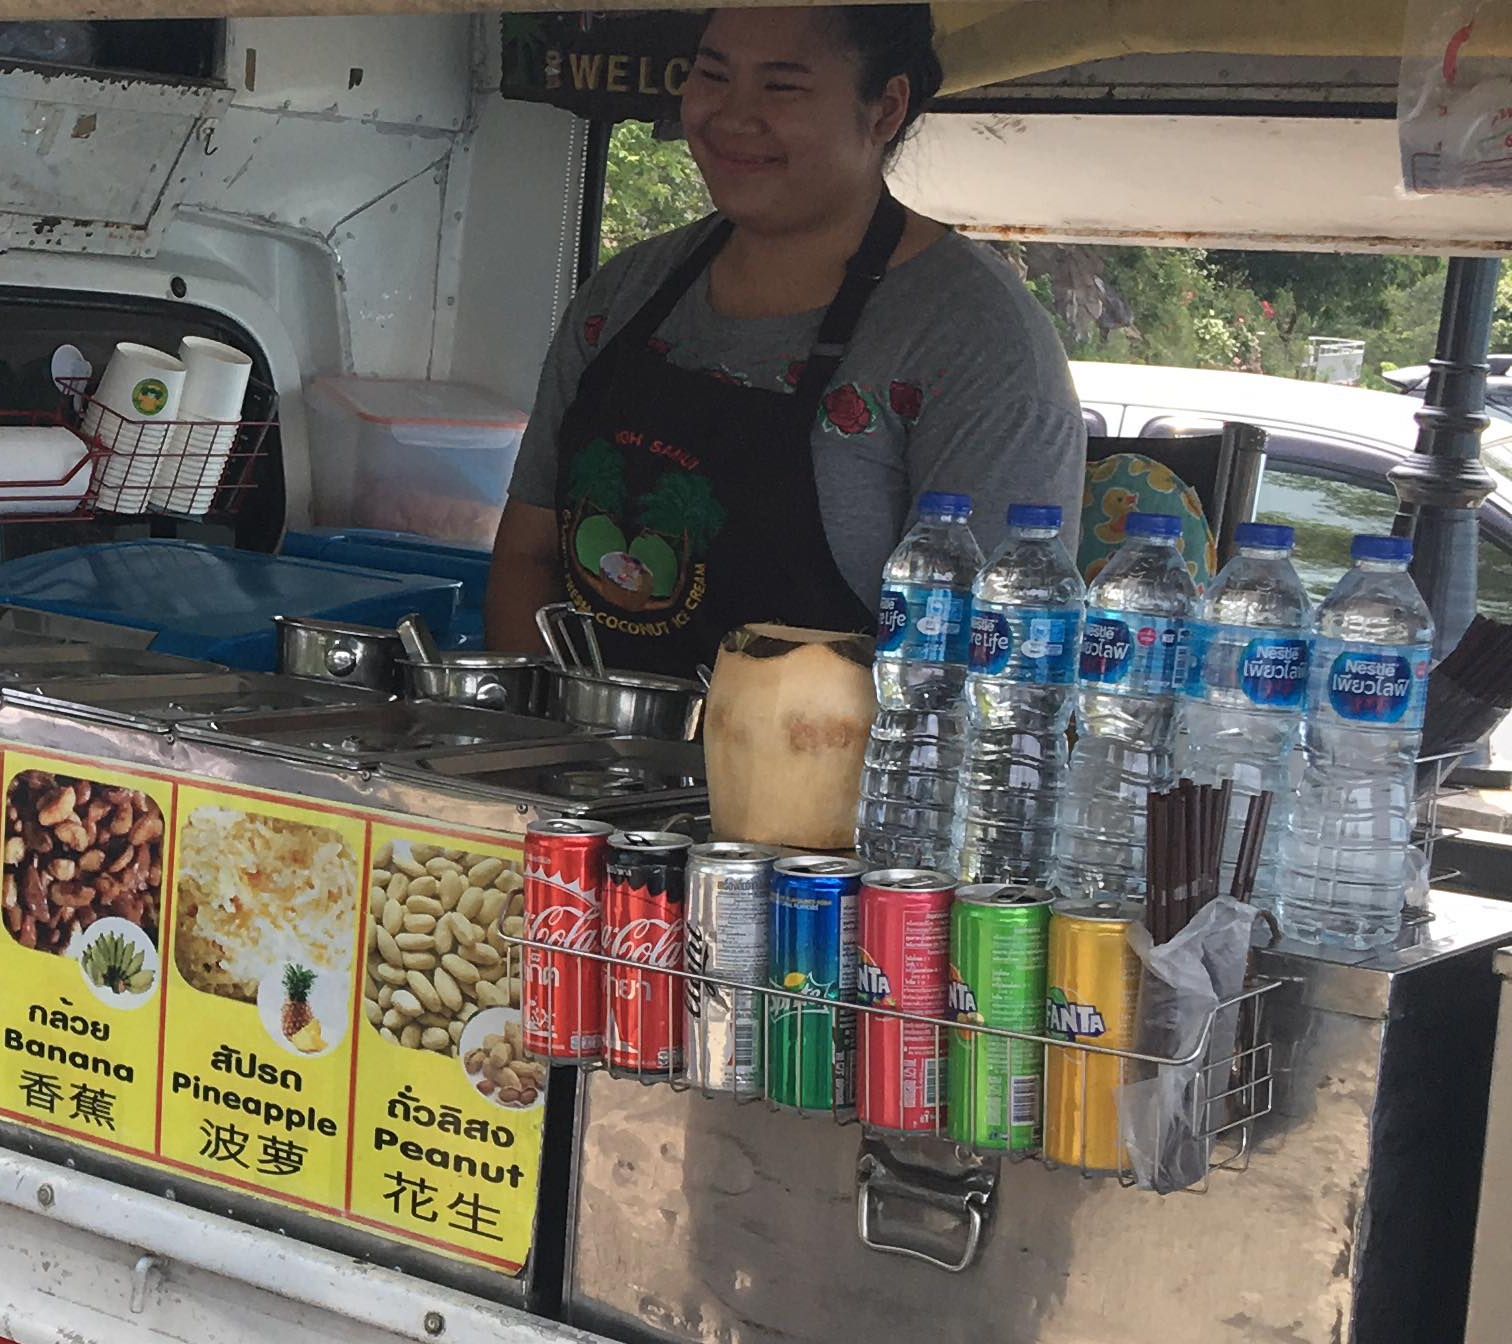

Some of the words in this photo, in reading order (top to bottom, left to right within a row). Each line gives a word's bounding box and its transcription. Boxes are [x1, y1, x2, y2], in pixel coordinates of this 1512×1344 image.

[569, 53, 689, 97] WELC
[594, 611, 671, 638] COCONUT
[686, 563, 707, 611] CREAM
[857, 964, 890, 996] NTA
[948, 981, 976, 1013] NTA
[28, 996, 110, 1042] กล้วย
[1046, 1002, 1105, 1035] FANTA
[4, 1027, 134, 1084] Banana
[18, 1069, 117, 1132] 香蕉
[172, 1070, 337, 1137] Pineapple
[388, 1084, 515, 1148] ถั่วลิสง
[199, 1118, 309, 1176] 波萝
[374, 1127, 525, 1189] Peanut
[382, 1170, 504, 1242] 花生
